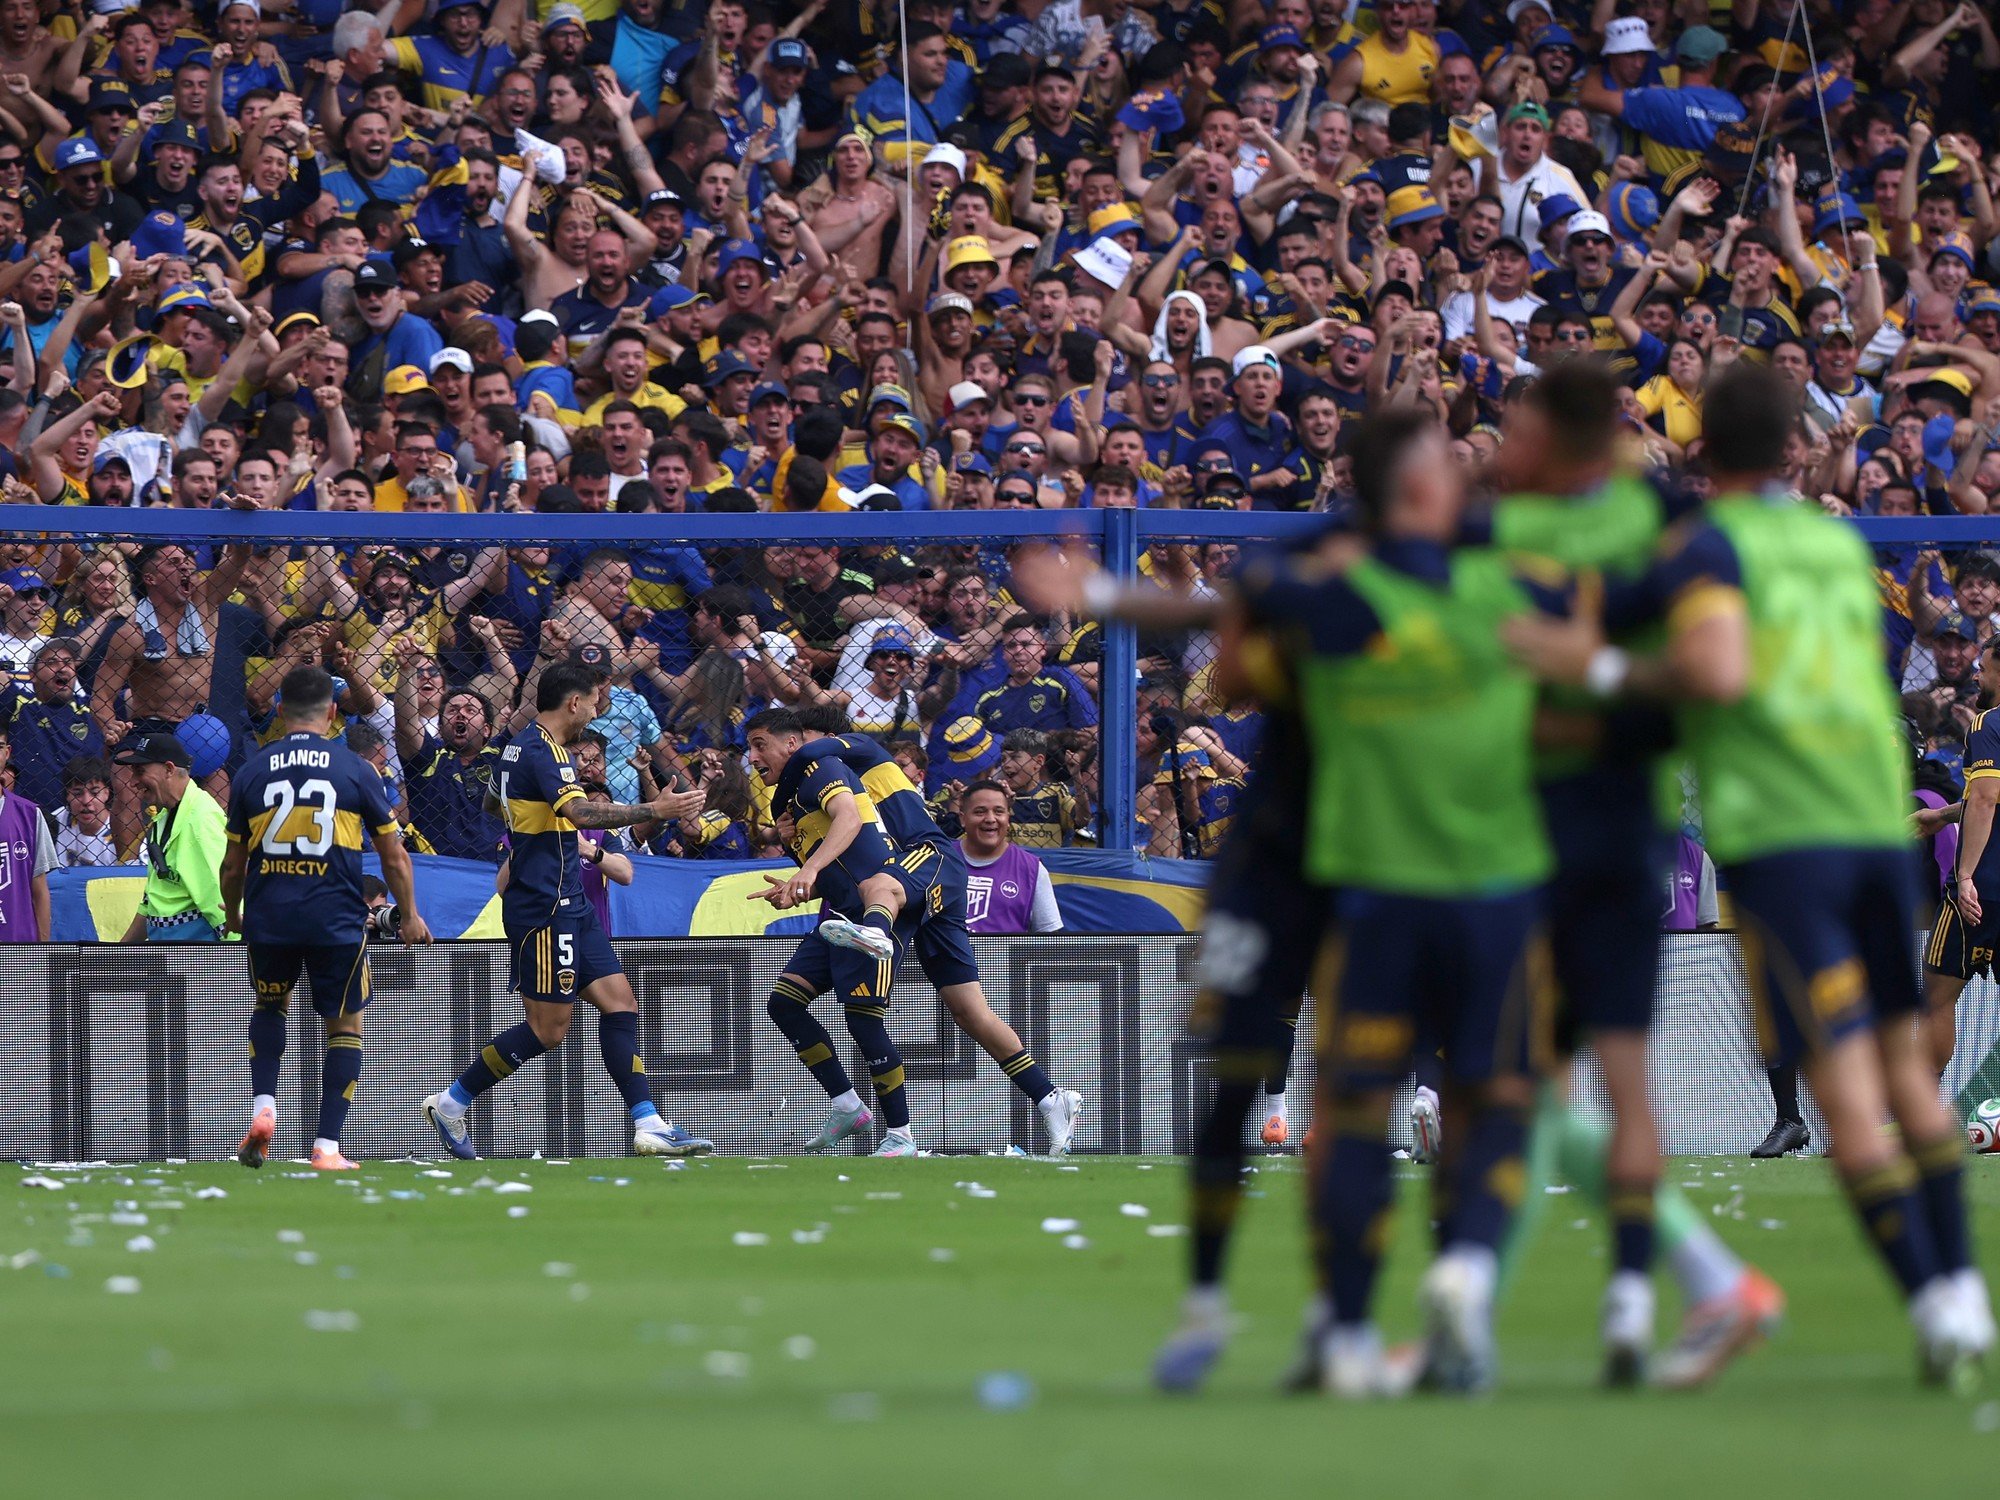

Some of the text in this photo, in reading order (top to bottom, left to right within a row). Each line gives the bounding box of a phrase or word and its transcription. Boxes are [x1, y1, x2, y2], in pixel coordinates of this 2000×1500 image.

[269, 749, 331, 772] BLANCO
[818, 779, 845, 798] TROGAR
[261, 778, 337, 857] 23
[259, 858, 329, 877] DIRECTV
[558, 933, 574, 966] 5
